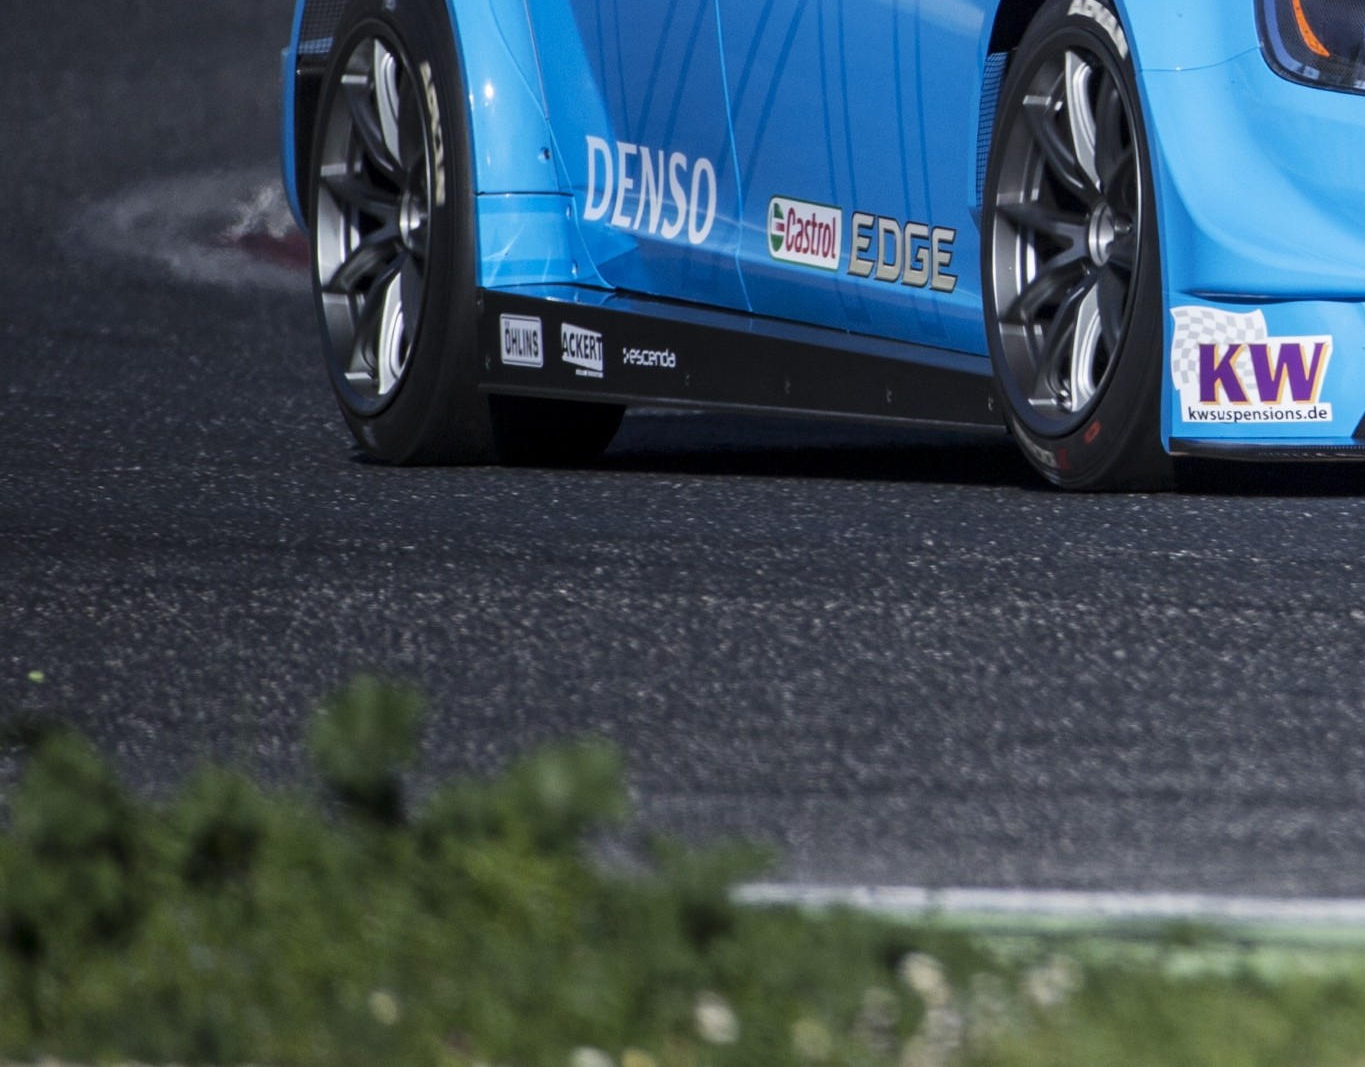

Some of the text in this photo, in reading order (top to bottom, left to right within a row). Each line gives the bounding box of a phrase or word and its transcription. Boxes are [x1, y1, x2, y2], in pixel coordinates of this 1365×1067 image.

[582, 134, 718, 245] DENSO
[785, 206, 959, 294] Castrol EDGE
[629, 348, 676, 368] escenda
[1198, 342, 1330, 406] KW
[1188, 405, 1328, 423] kwsuspensions.de
